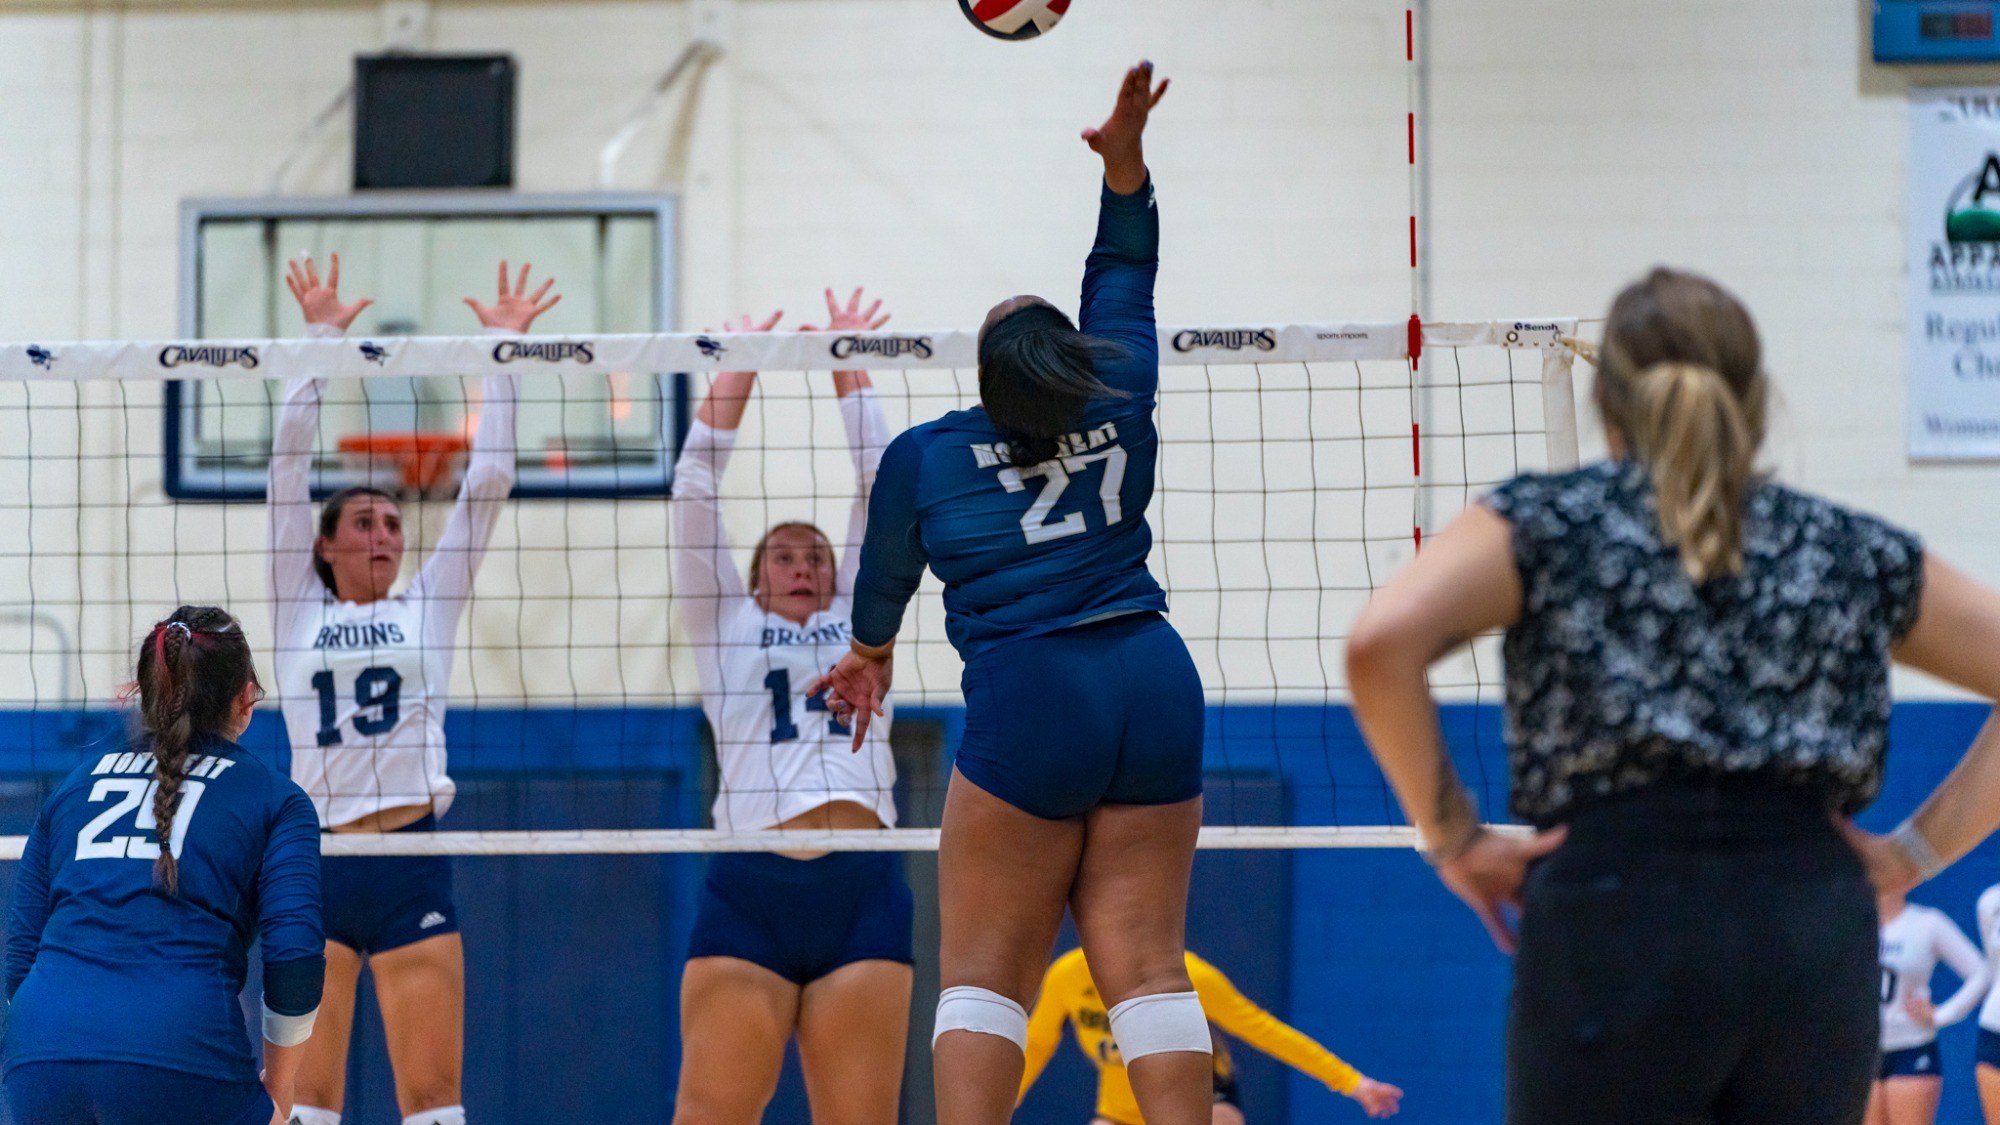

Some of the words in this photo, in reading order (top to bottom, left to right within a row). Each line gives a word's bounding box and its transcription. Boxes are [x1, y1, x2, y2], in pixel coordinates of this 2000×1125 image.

[1524, 323, 1558, 331] Senoh
[492, 340, 594, 364] CAVALIERS
[830, 335, 933, 359] CAVALIERS
[1172, 328, 1276, 353] CAVALIERS
[158, 345, 259, 369] CAVALIERS
[997, 444, 1128, 545] 27
[312, 622, 405, 649] BRUINS
[311, 666, 403, 748] 19
